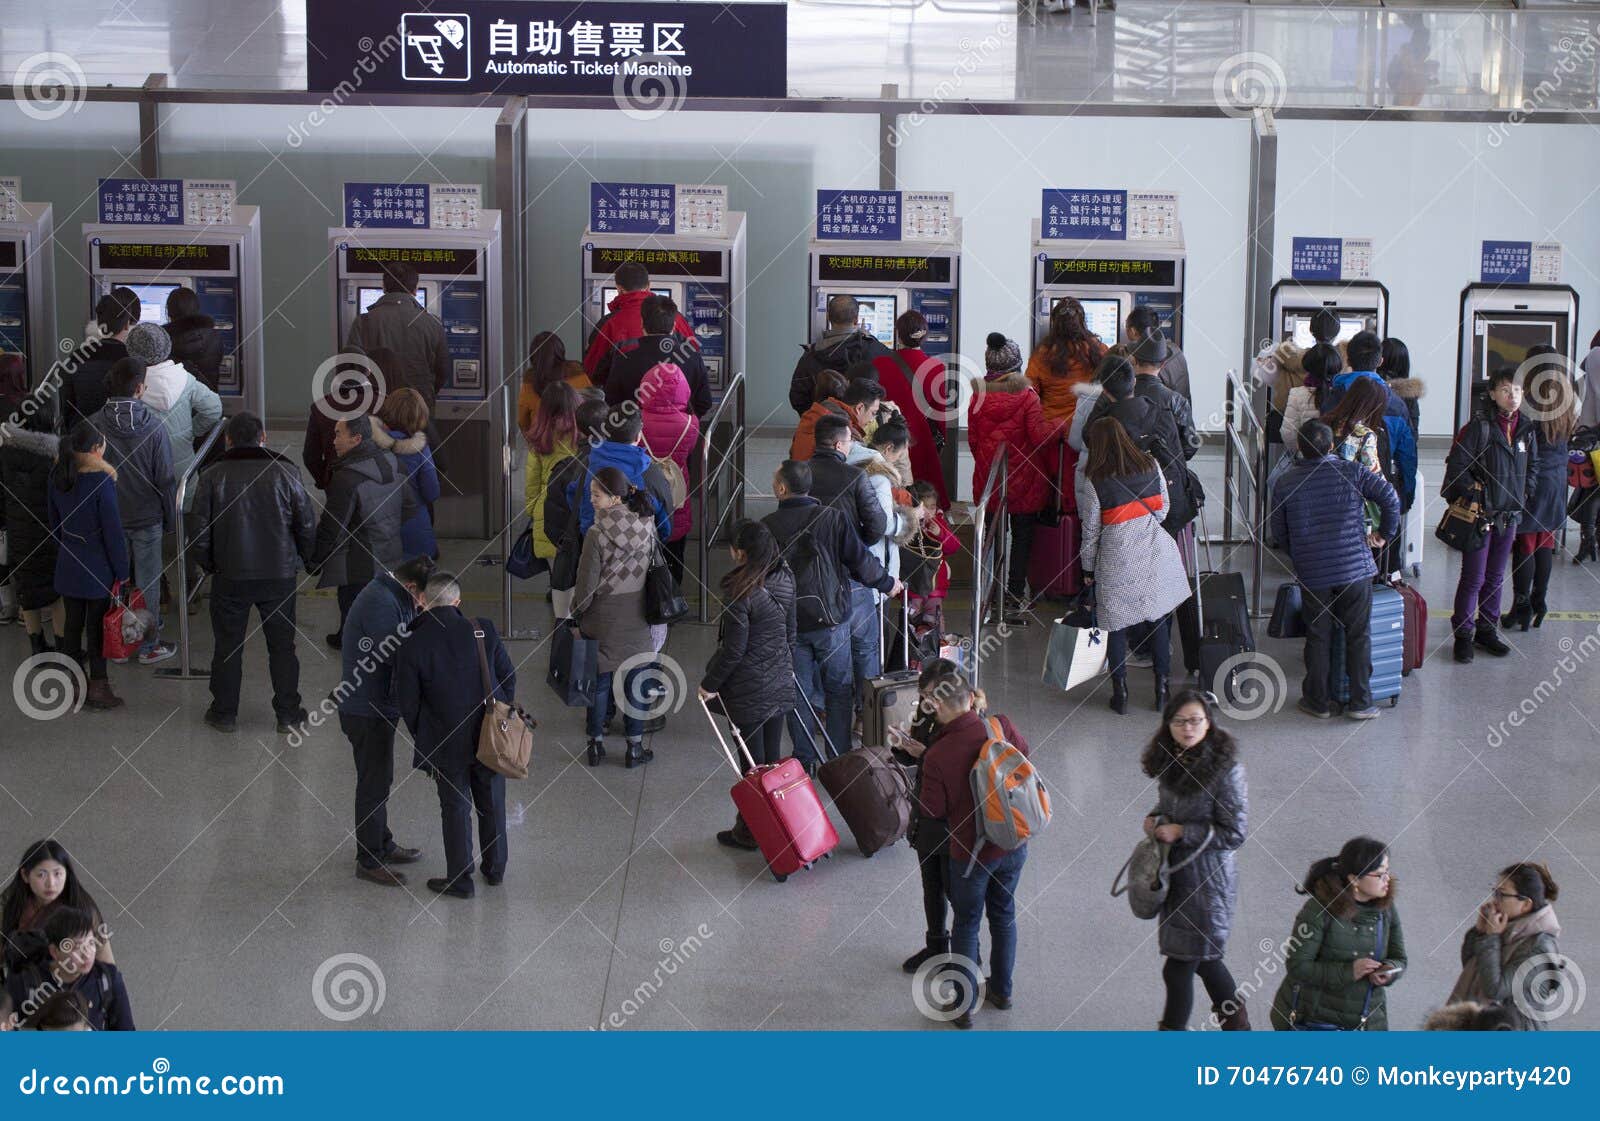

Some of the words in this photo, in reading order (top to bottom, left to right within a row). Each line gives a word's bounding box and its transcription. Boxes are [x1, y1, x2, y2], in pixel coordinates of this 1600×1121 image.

[488, 18, 686, 57] 自助售票区
[485, 59, 569, 76] Automatic
[571, 60, 620, 76] Ticket
[623, 61, 692, 77] Machine
[828, 257, 928, 270] 欢迎使用自动售票机
